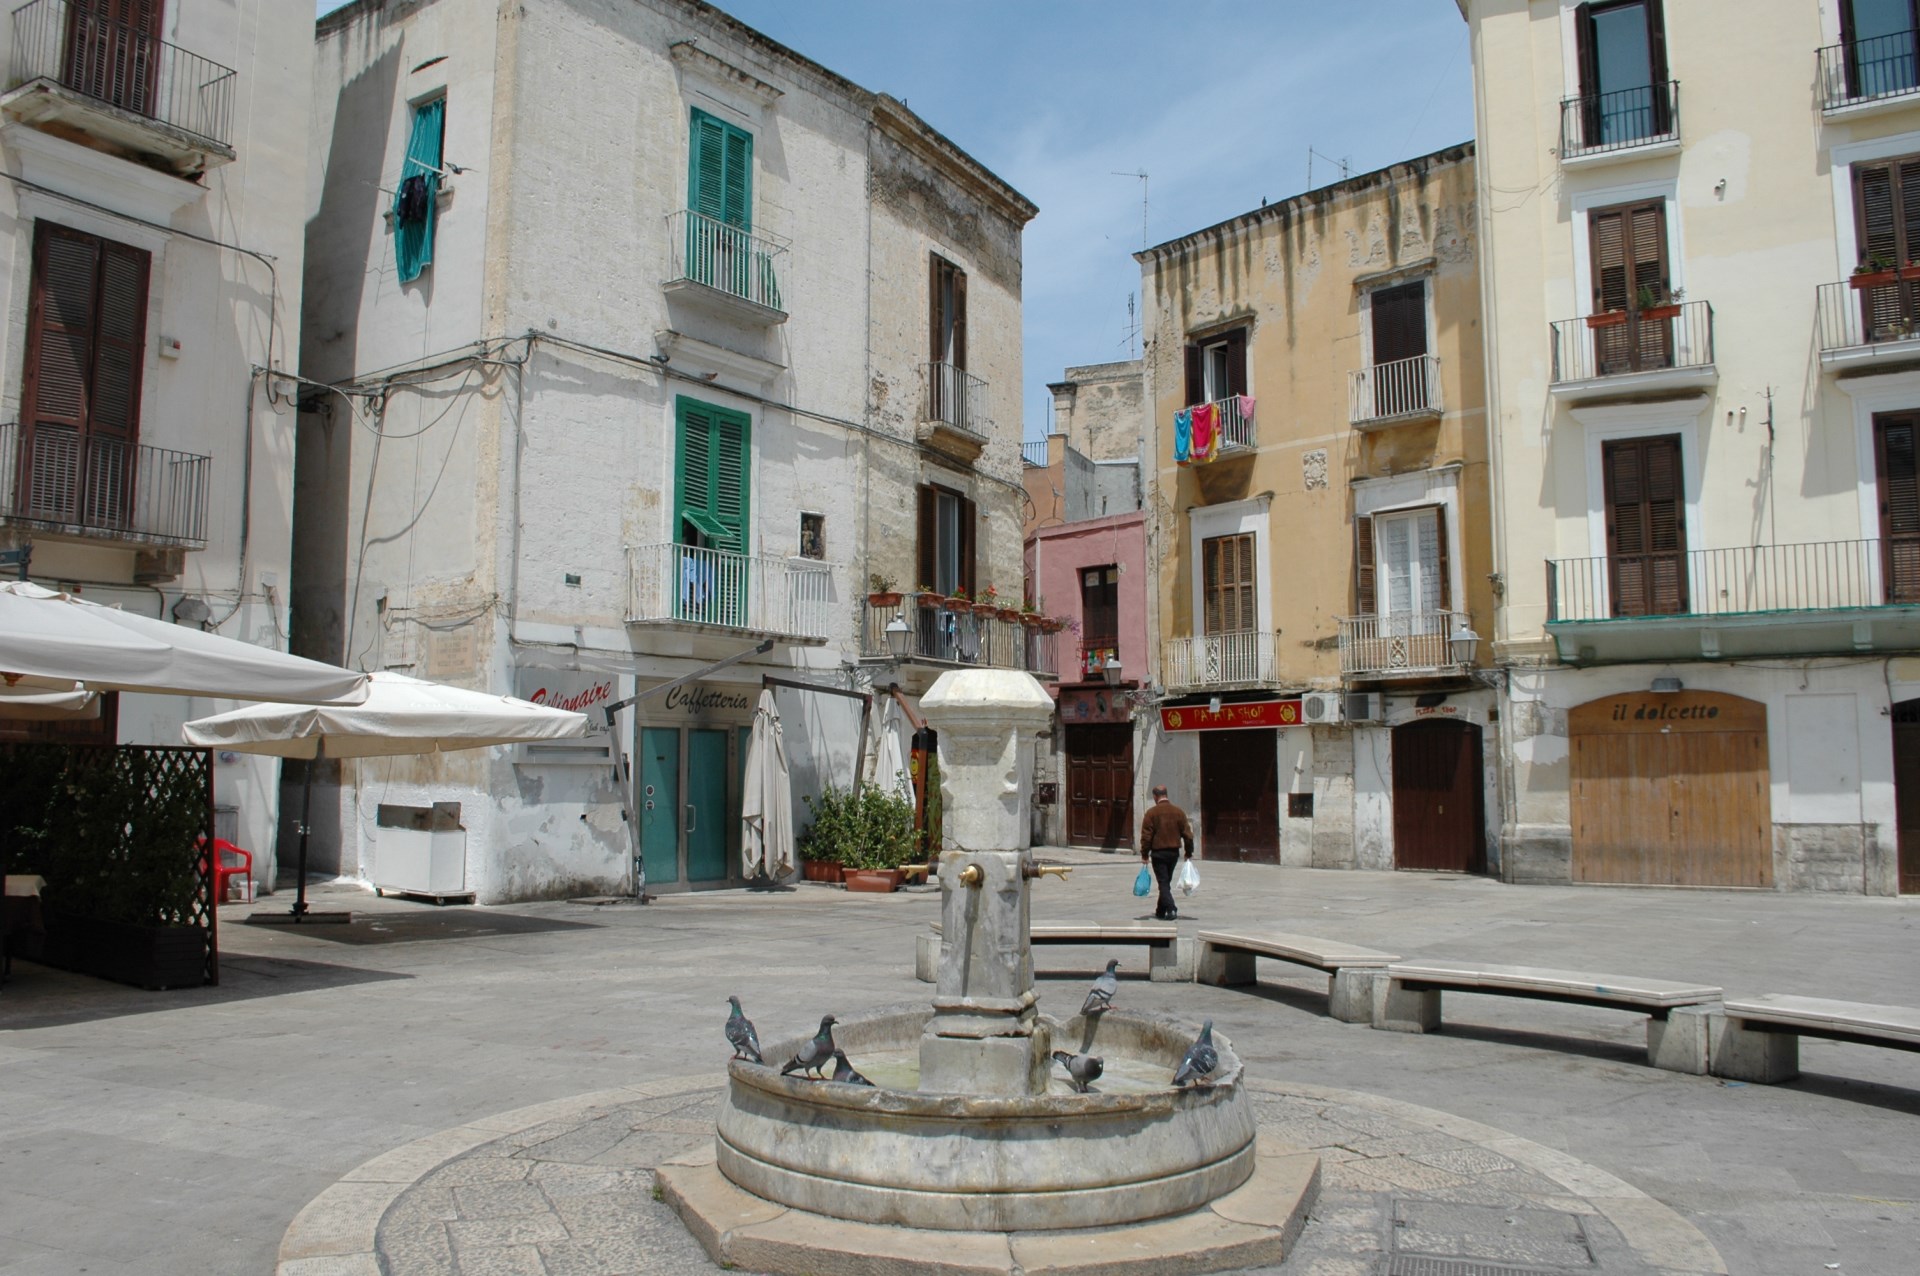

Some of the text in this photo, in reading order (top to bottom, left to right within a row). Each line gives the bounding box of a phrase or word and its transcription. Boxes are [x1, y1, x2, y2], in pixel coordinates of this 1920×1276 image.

[665, 685, 748, 714] Caffetteria
[1193, 707, 1236, 722] PATATA
[1238, 705, 1265, 719] SHOP
[1612, 703, 1719, 720] il dolcetto
